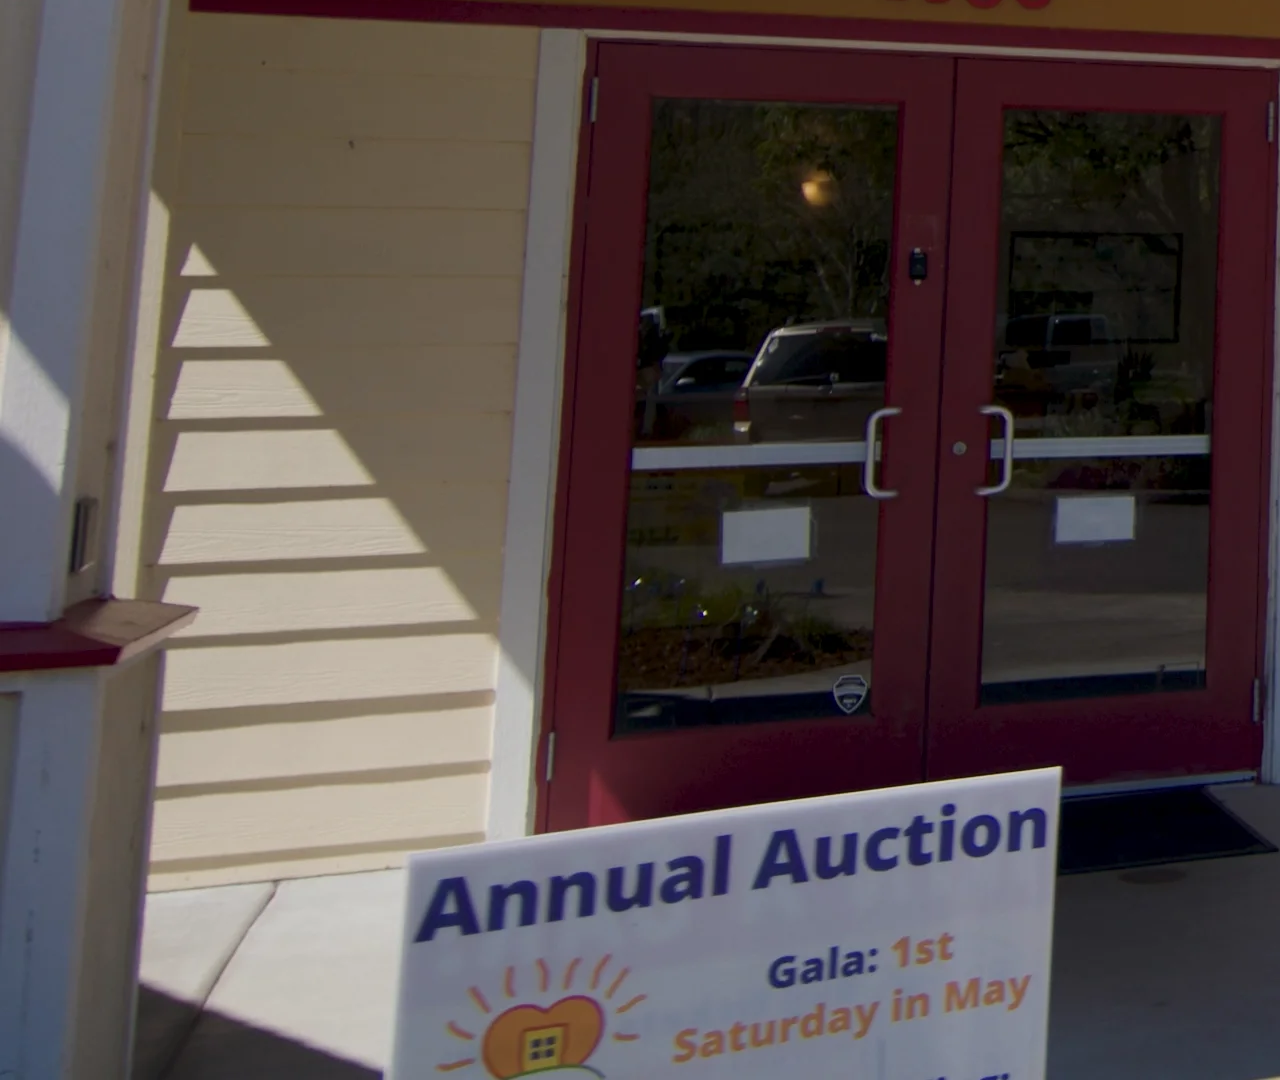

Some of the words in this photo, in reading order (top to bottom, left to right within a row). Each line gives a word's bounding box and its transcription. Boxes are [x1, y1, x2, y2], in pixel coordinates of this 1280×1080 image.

[413, 834, 732, 944] Annual
[751, 803, 1049, 891] Auction
[768, 945, 879, 989] Gala:
[890, 931, 955, 969] 1st
[672, 998, 881, 1064] Saturday
[891, 988, 930, 1024] in
[944, 971, 1032, 1014] May
